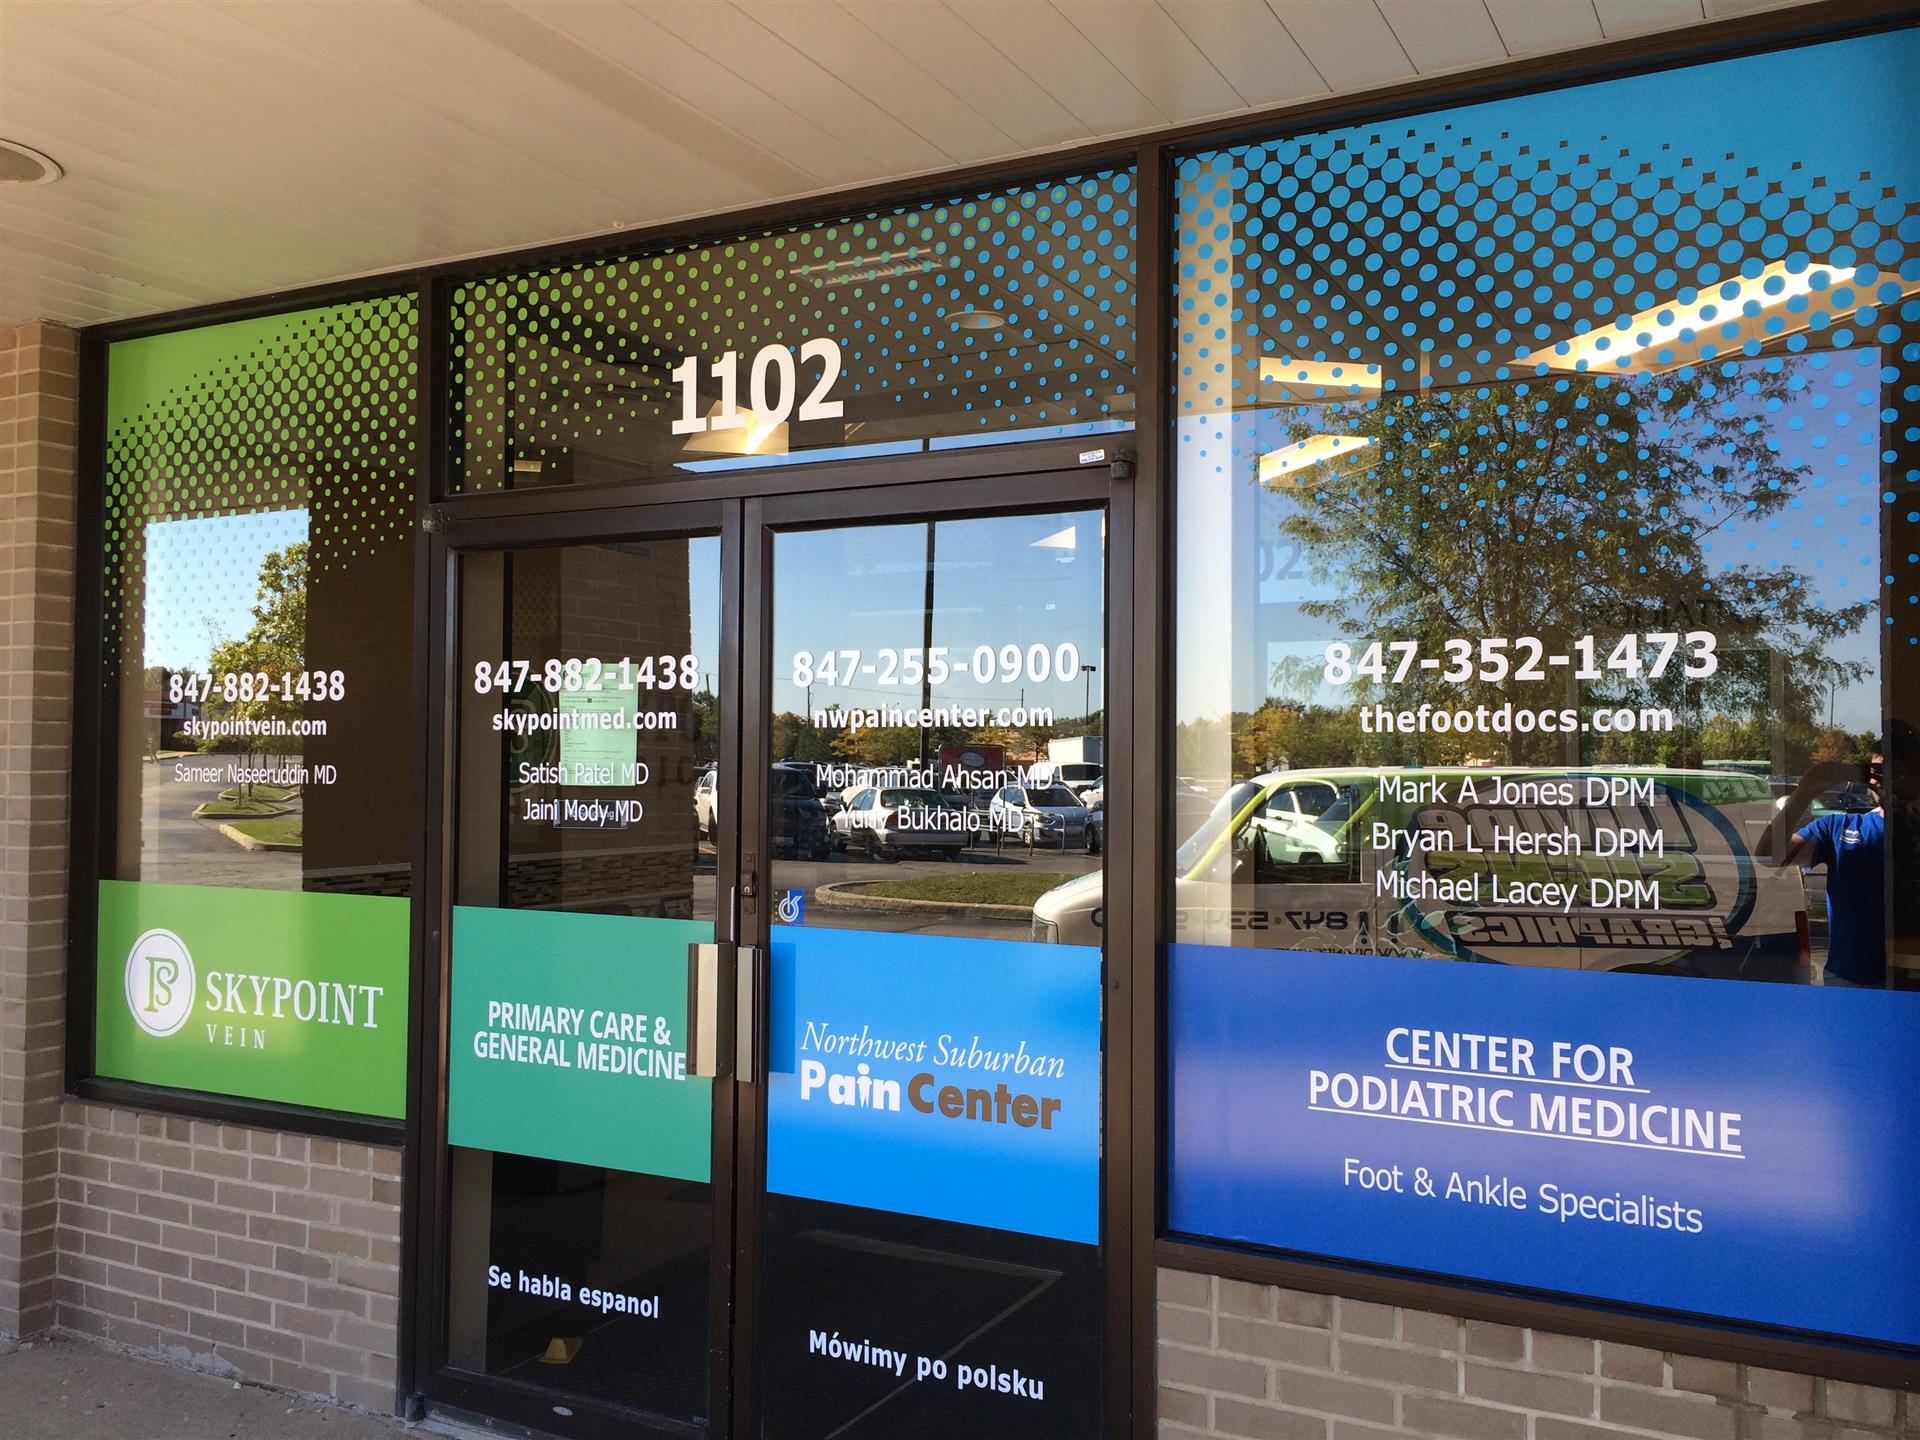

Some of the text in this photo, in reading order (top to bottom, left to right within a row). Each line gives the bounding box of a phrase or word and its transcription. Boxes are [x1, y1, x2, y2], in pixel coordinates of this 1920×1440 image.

[671, 337, 844, 435] 1102
[474, 654, 700, 694] 847-882-1438
[792, 642, 1081, 687] 847-255-0900
[1322, 631, 1718, 685] 847-352-1473
[169, 669, 346, 703] 847-882-1438
[183, 716, 327, 741] skypointvein.com
[492, 708, 677, 737] skypointmed.com
[814, 703, 1054, 733] nwpaincenter.com
[1359, 703, 1673, 734] thefootdocs.com
[174, 763, 337, 785] Sameer Naseeruddin MD
[519, 762, 568, 785] Satish
[575, 762, 614, 785] Patel
[621, 763, 649, 785] MD
[816, 764, 1053, 790] Mohammad Ahsan MD
[1378, 775, 1656, 807] Mark A Jones DPM
[523, 798, 558, 821] Jaini
[564, 799, 609, 828] Mody
[615, 800, 643, 823] MD
[897, 804, 980, 832] Bukhalo
[989, 806, 1024, 833] MD
[1372, 822, 1665, 859] Bryan L Hersh DPM
[1375, 870, 1661, 913] Michael Lacey DPM
[206, 971, 384, 1028] SKYPOINT
[207, 1023, 266, 1049] VEIN
[488, 1000, 671, 1045] PRIMARY CARE &
[473, 1031, 686, 1081] GENERAL MEDICINE
[801, 1021, 1065, 1079] Northwest Suburban
[1385, 1026, 1636, 1086] CENTER FOR
[800, 1059, 1062, 1130] Pain Center
[1309, 1070, 1743, 1153] PODIATRIC MEDICINE
[1343, 1158, 1704, 1234] Foot & Ankle Specialists
[488, 1264, 660, 1319] Se habla espanol
[808, 1329, 1045, 1401] Mówimy po polsku
